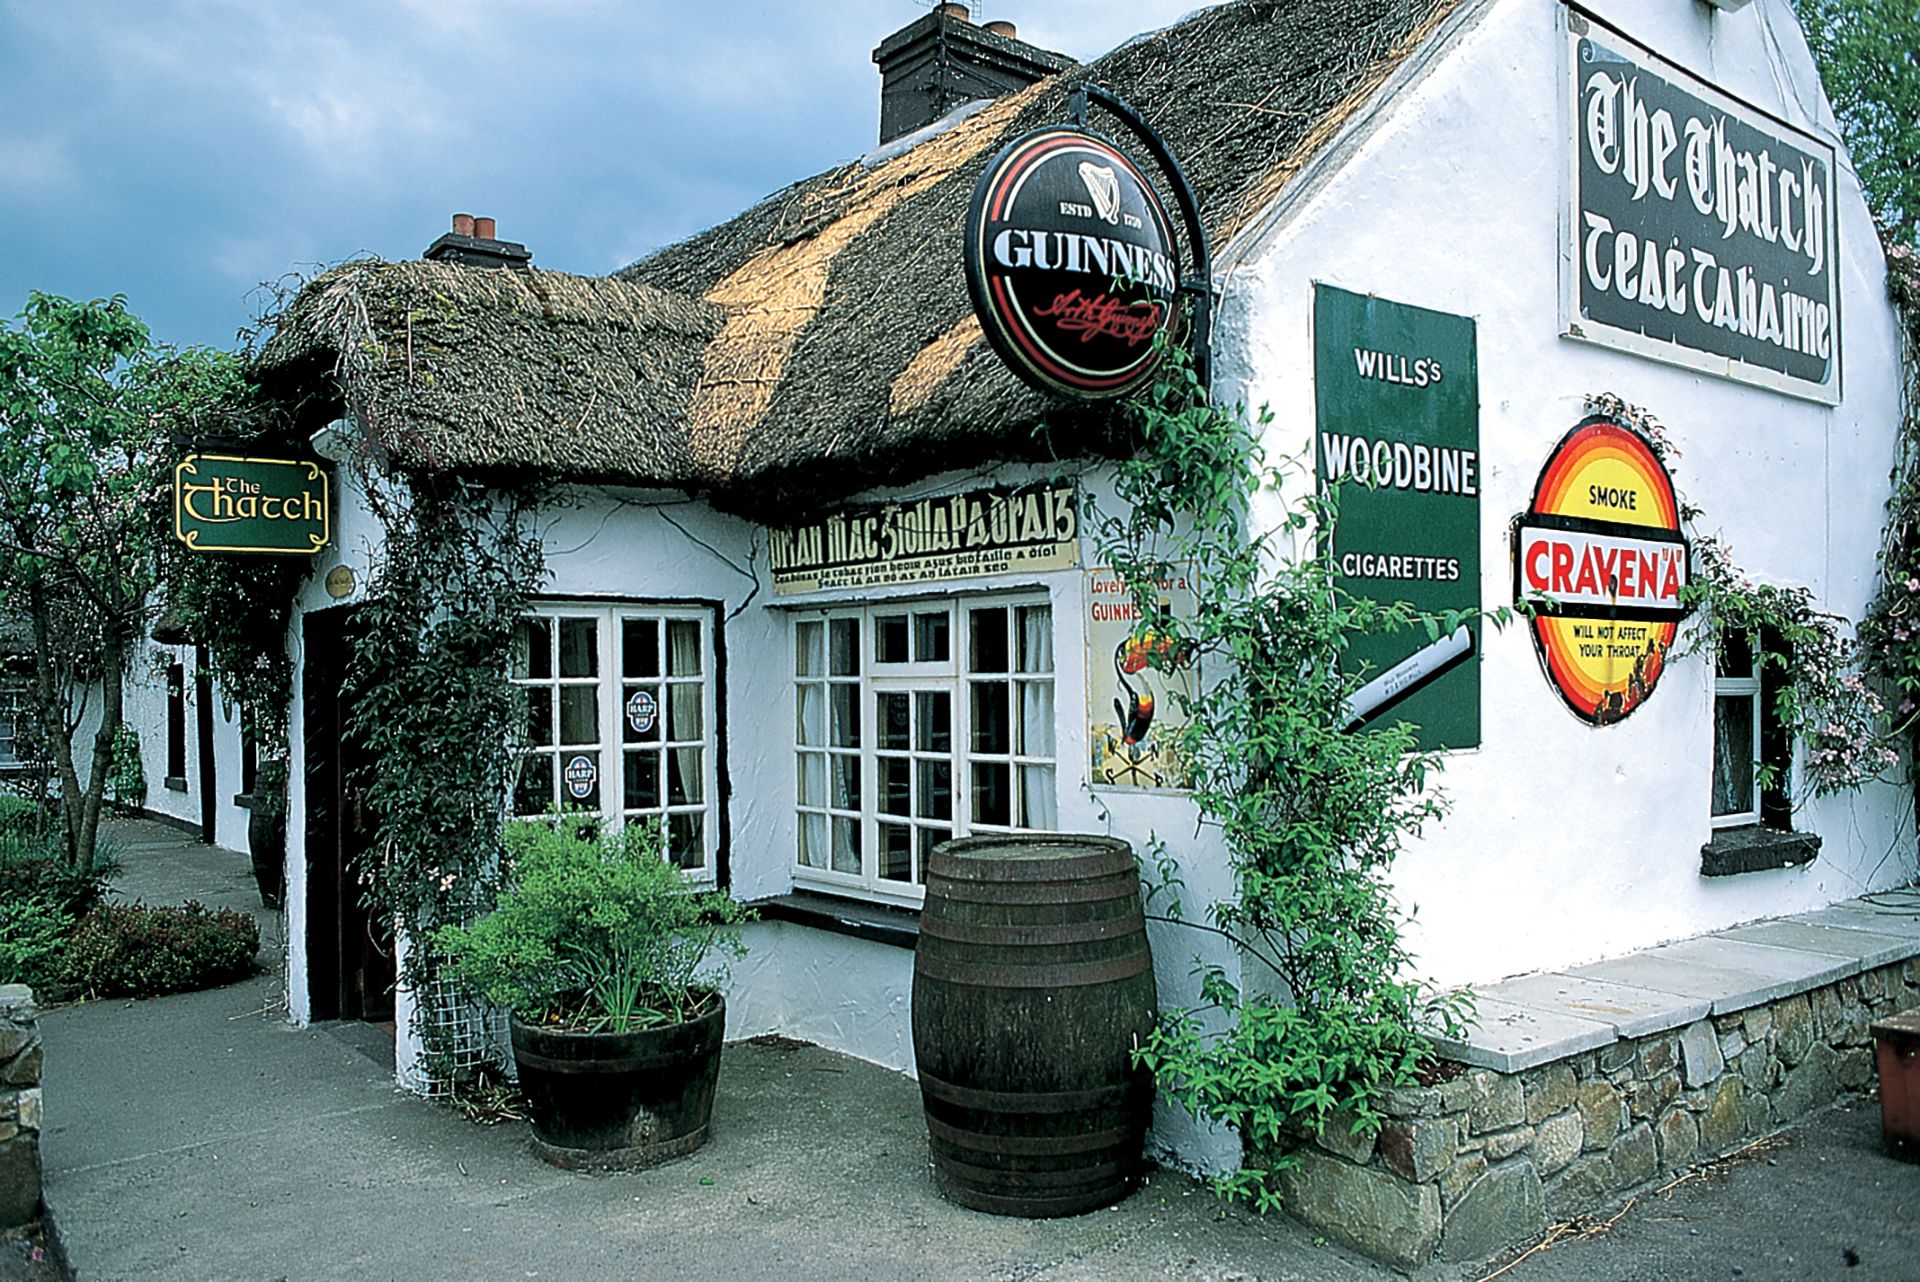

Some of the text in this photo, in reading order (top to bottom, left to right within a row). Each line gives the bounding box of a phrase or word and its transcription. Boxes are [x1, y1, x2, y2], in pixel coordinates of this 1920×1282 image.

[1586, 71, 1828, 276] The Thatch
[1060, 202, 1092, 218] ESTD
[993, 229, 1176, 294] GUINNESS
[1322, 432, 1477, 495] WOODBINE
[226, 477, 261, 495] The
[183, 477, 323, 523] Thatch
[1588, 485, 1637, 510] SMOKE
[1342, 553, 1459, 580] CIGARETTES
[1525, 540, 1659, 601] CRAVEN
[1091, 577, 1125, 596] Lovely
[1178, 577, 1186, 590] a
[1573, 625, 1647, 641] WILL NOT AFFECT
[1579, 644, 1641, 658] YOUR THROAT
[630, 704, 653, 713] HARP
[568, 769, 593, 779] HARP
